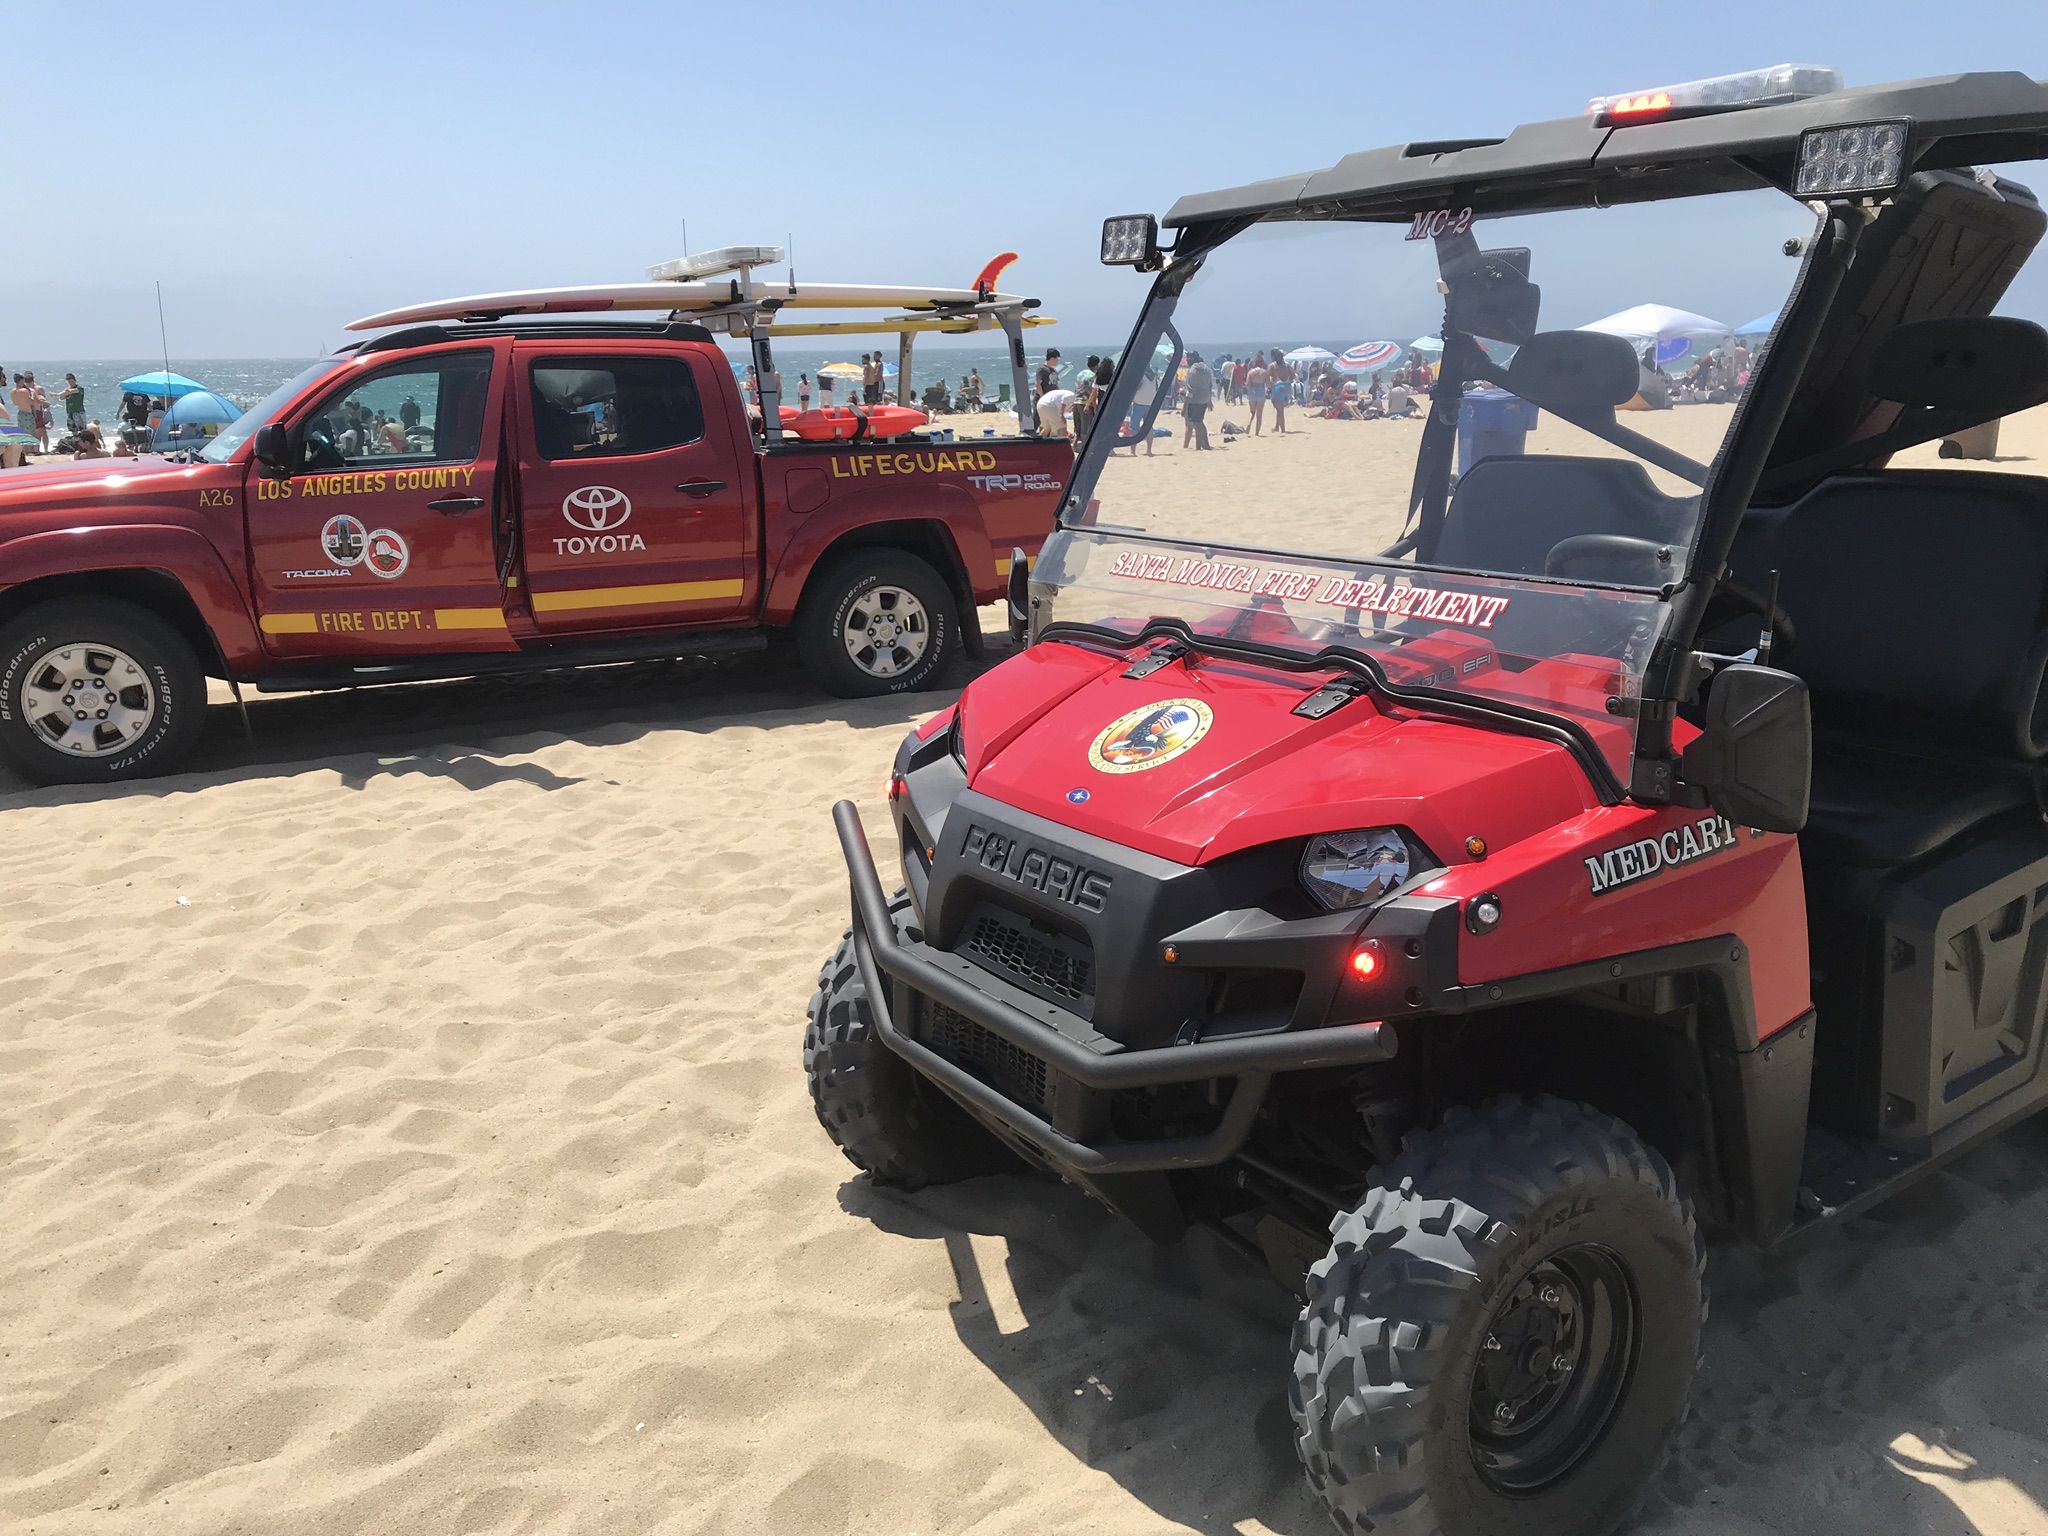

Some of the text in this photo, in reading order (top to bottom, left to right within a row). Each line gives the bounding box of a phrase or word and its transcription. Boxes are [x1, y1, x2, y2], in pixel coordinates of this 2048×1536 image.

[1405, 206, 1473, 240] MC-2
[831, 451, 997, 478] LIFEGUARD
[258, 467, 476, 500] LOS ANGELES COUNTY
[967, 473, 1052, 492] TRD OFF
[1024, 481, 1062, 490] ROAD
[199, 488, 234, 508] A26
[553, 534, 647, 556] TOYOTA
[281, 568, 352, 579] TACOMA
[1109, 550, 1511, 630] SANTA MONICA FIRE DEPARTMENT
[321, 610, 431, 632] FIRE DEPT.
[1462, 654, 1491, 674] EFI
[960, 823, 1113, 914] POLARIS
